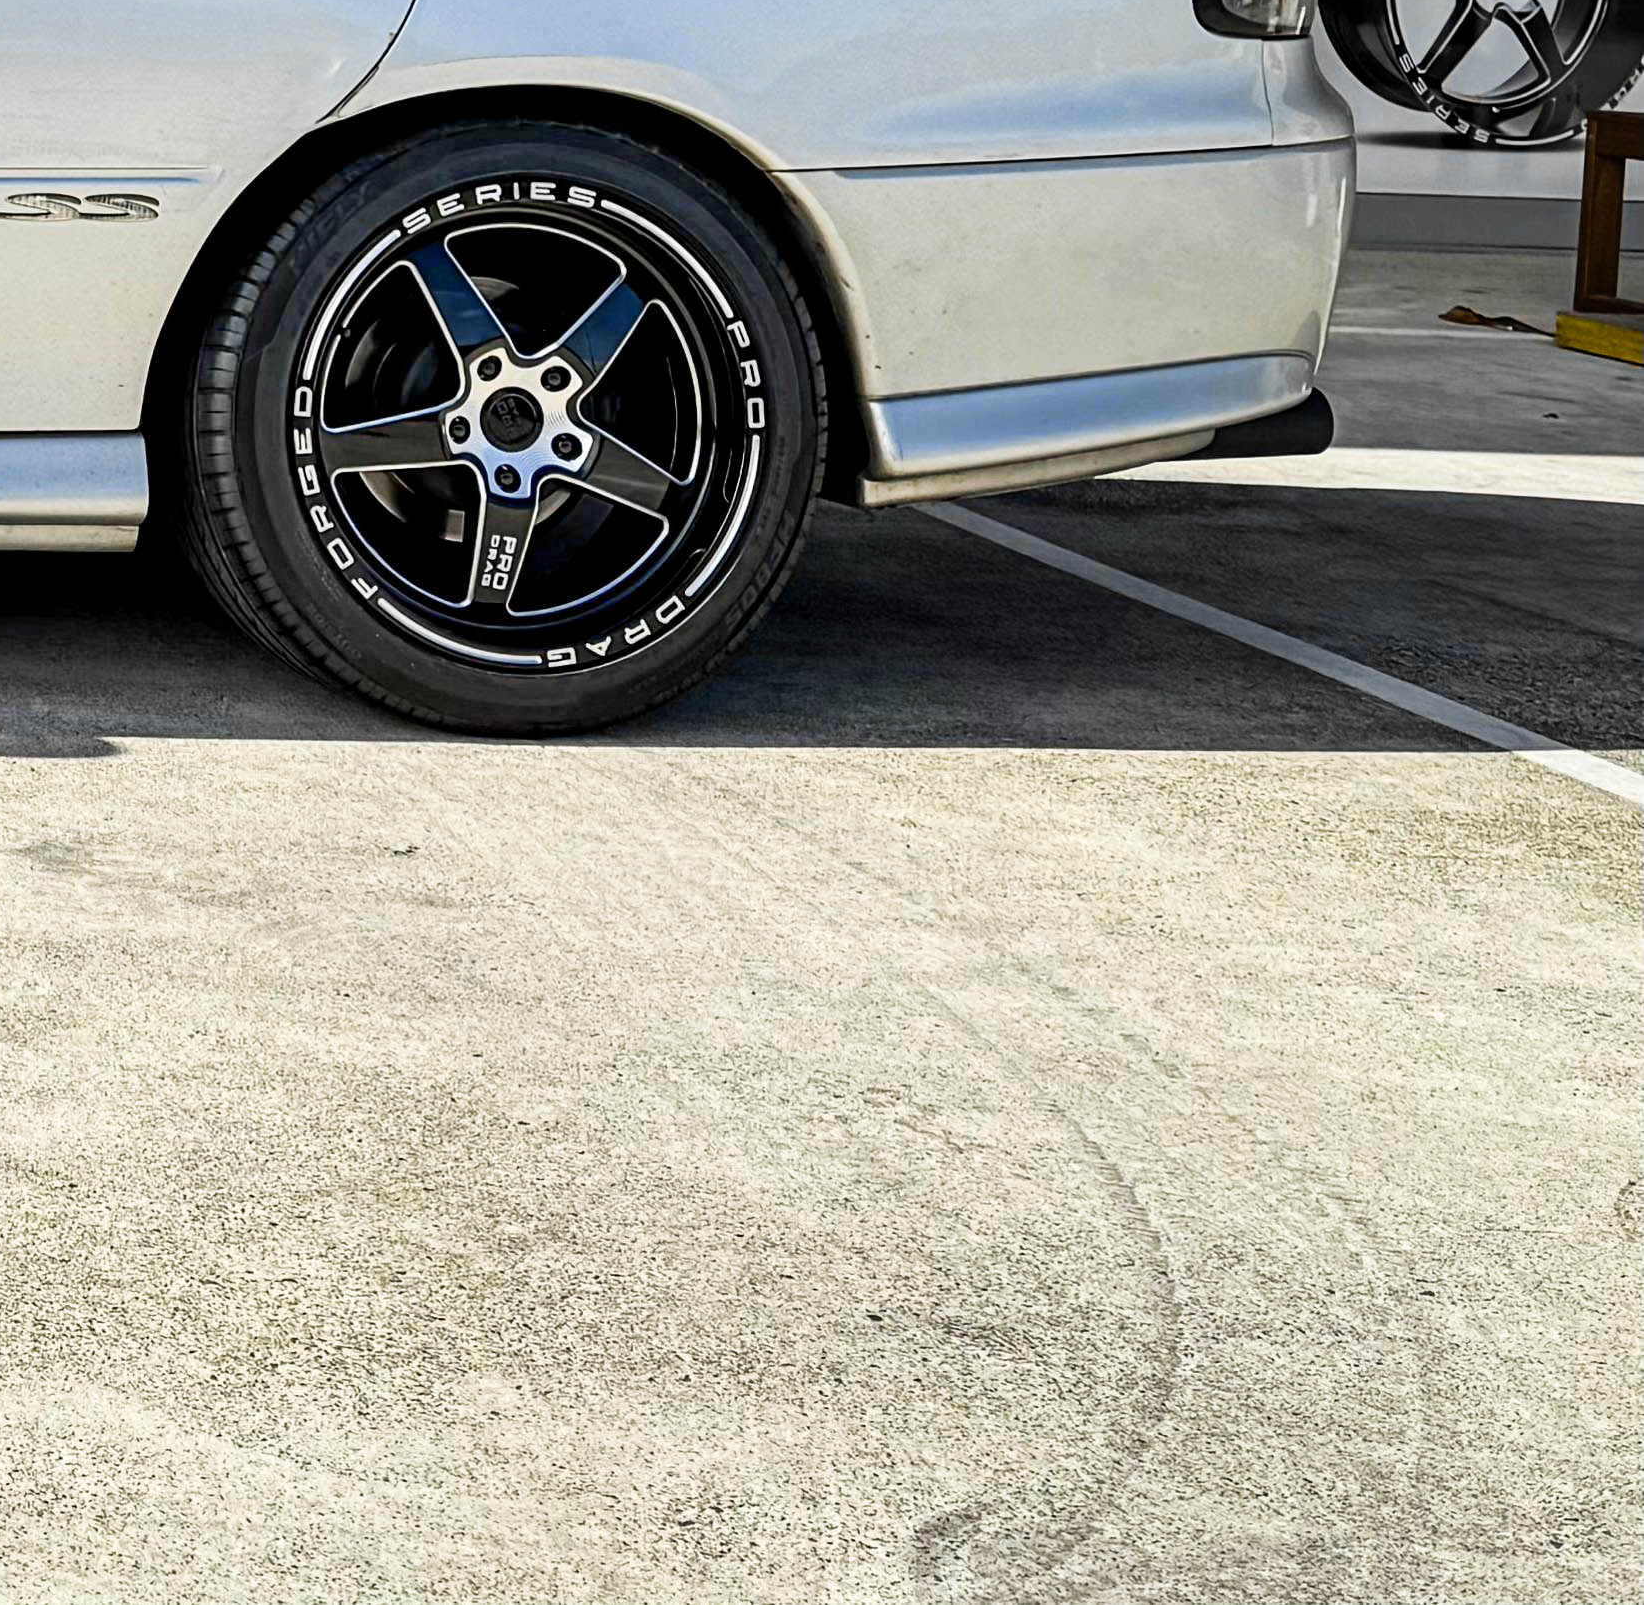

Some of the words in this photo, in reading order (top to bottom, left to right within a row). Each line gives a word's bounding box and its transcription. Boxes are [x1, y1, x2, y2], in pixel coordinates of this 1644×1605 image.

[1398, 52, 1491, 143] SERIES
[402, 181, 597, 235] SERIES
[726, 320, 766, 429] PRO
[293, 386, 379, 600] FORGED
[481, 534, 501, 587] DRAG
[492, 535, 518, 590] PRO
[546, 595, 686, 668] DRAG
